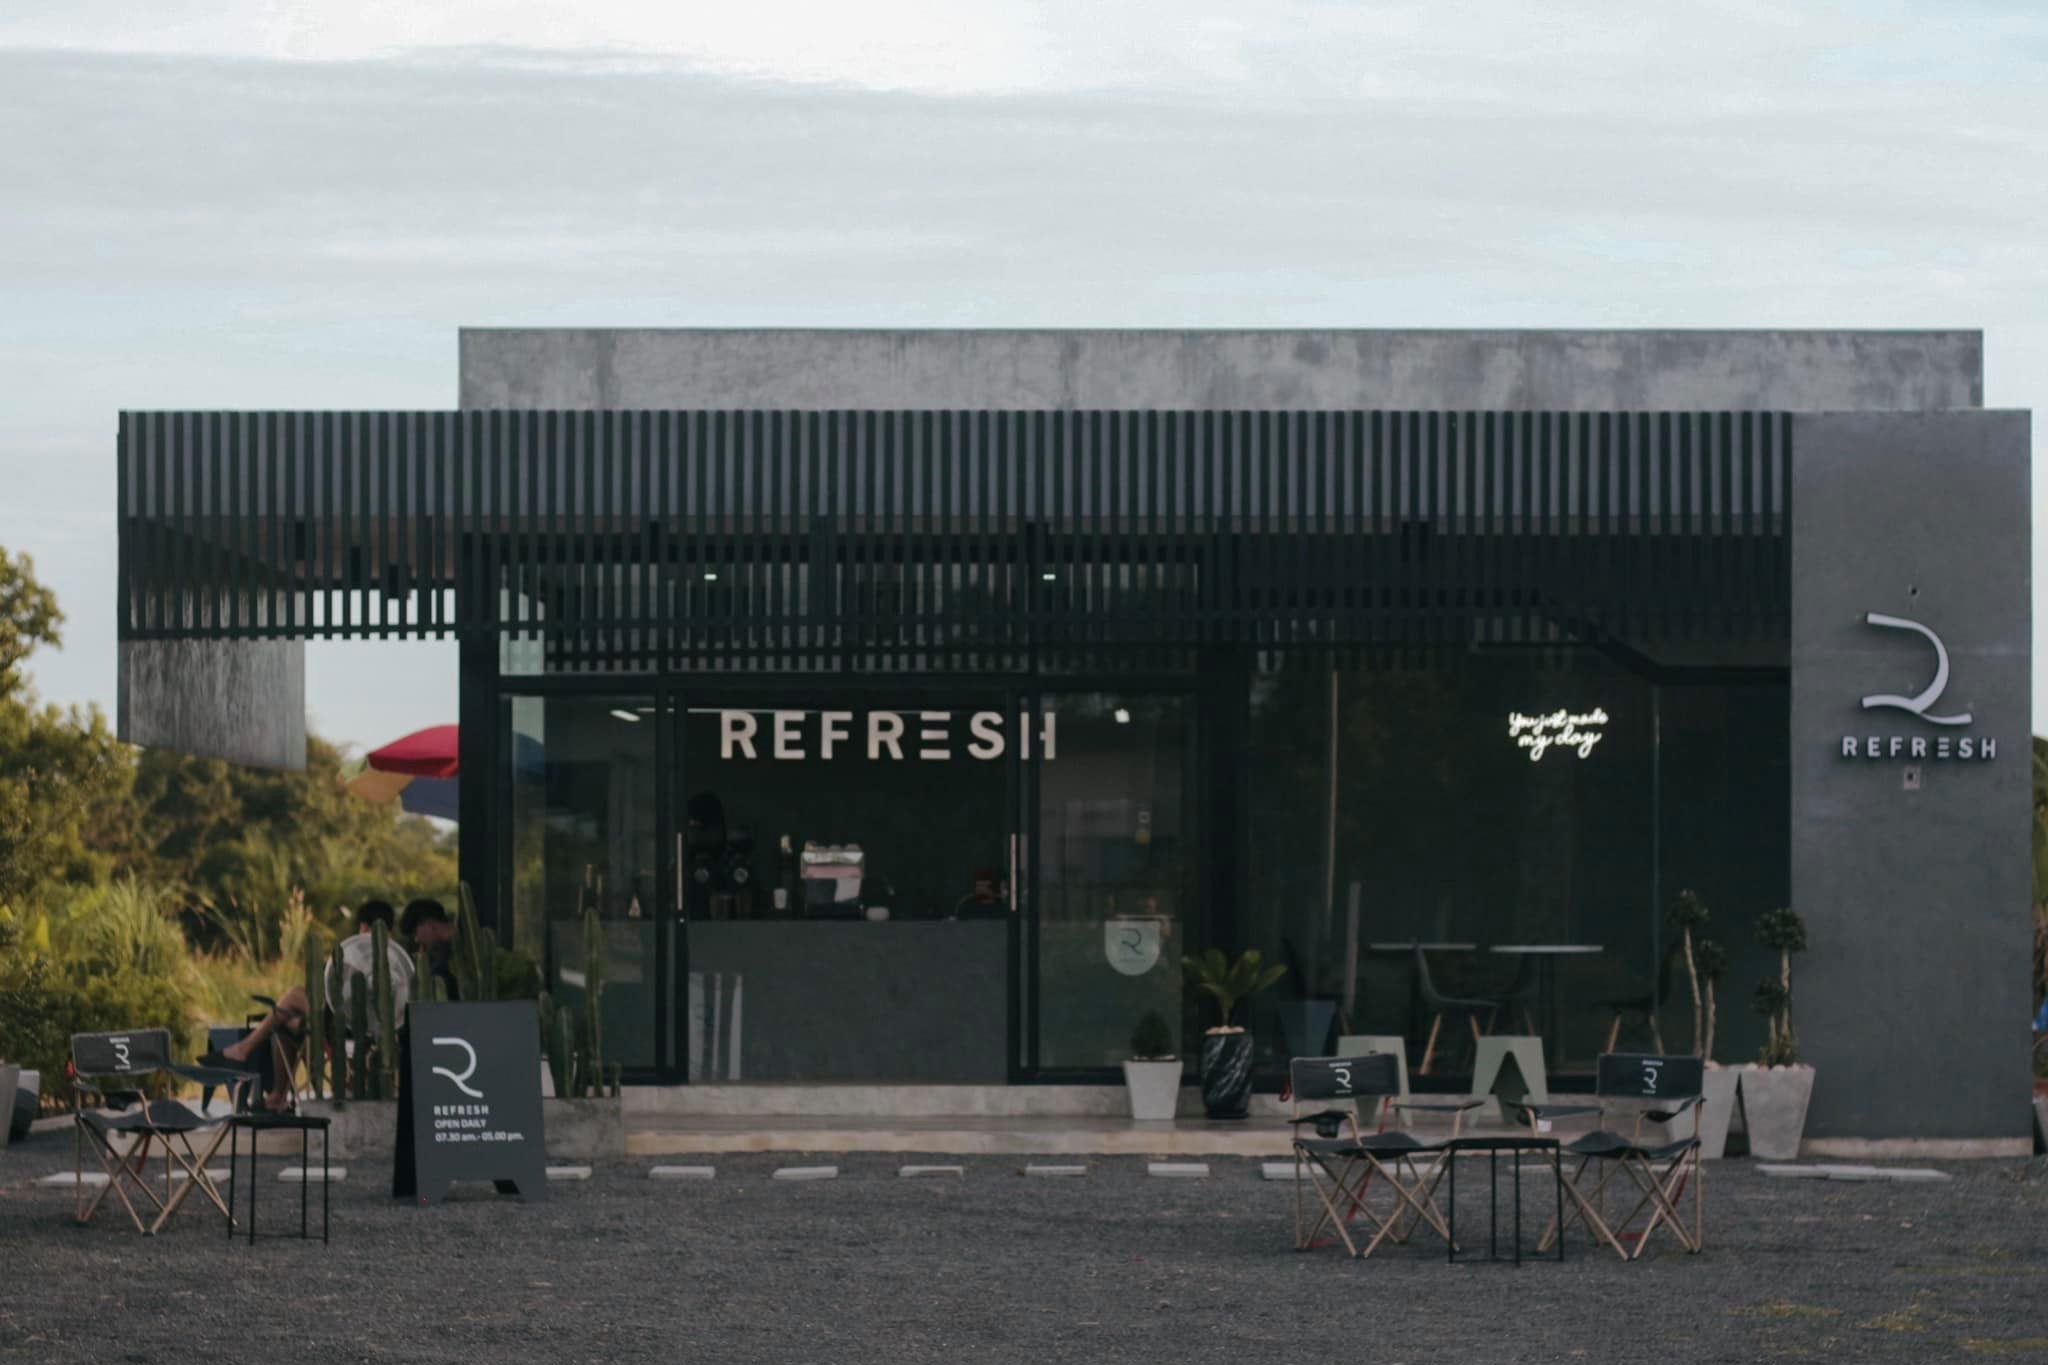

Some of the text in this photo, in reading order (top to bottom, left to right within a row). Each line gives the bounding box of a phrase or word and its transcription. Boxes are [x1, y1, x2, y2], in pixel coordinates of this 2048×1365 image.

[1567, 706, 1609, 726] made
[720, 710, 1056, 760] REFRESH
[1517, 723, 1603, 762] my day
[1842, 736, 1996, 758] REFRESH
[433, 1104, 490, 1116] REFRESH
[434, 1119, 488, 1129] OPEN DAILY
